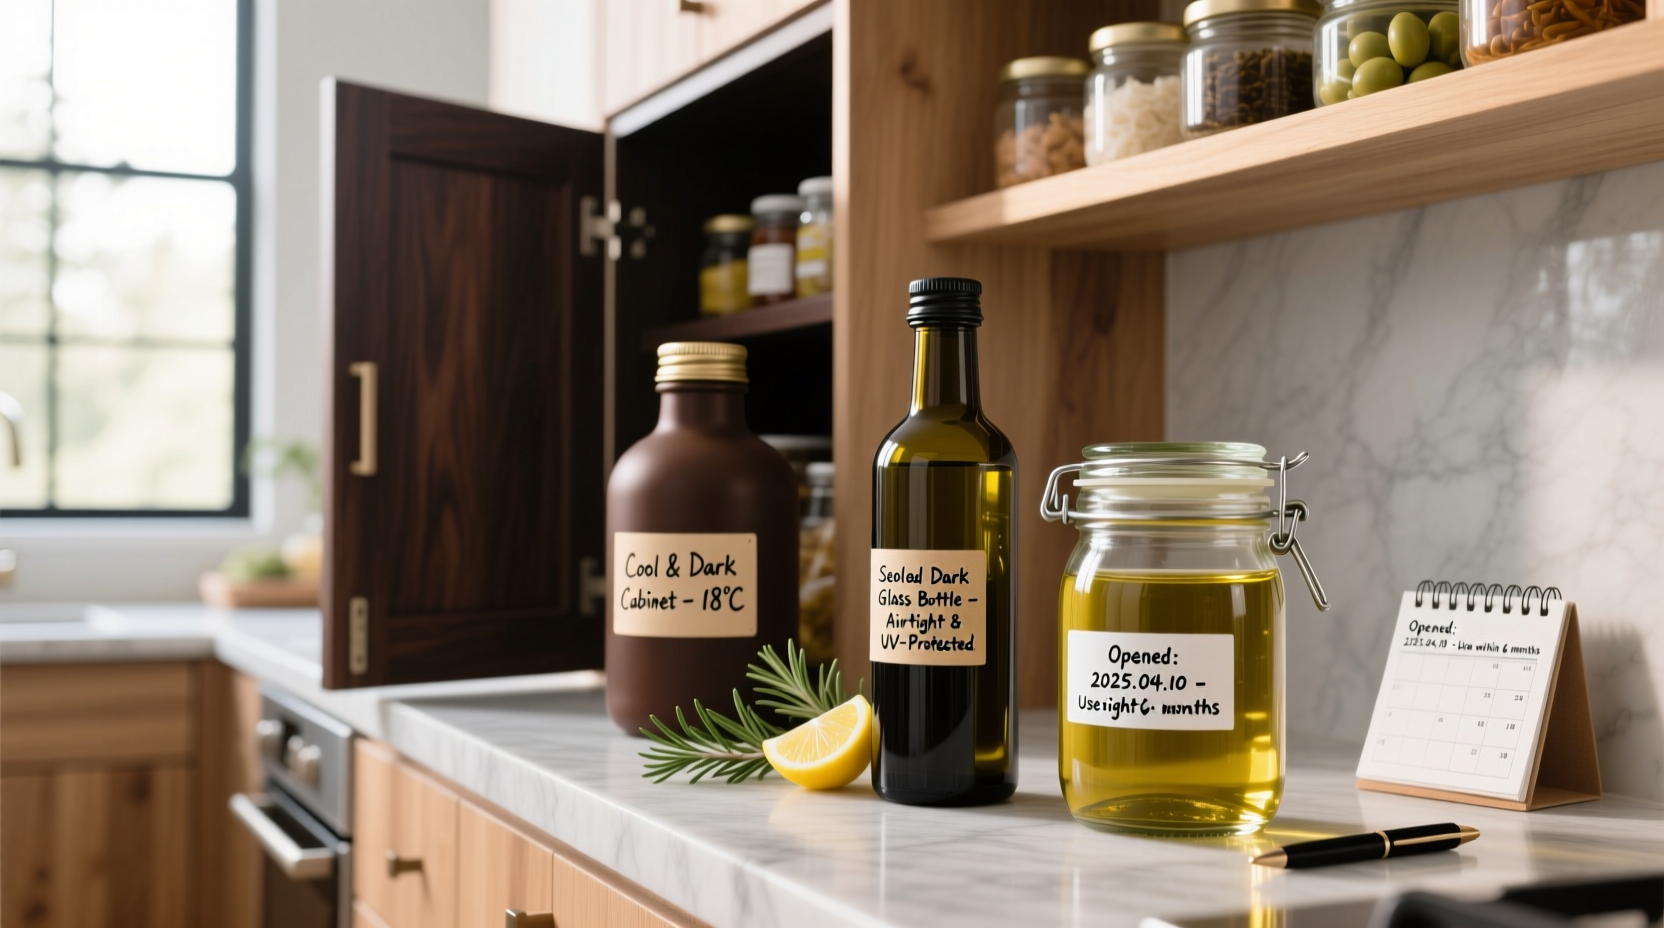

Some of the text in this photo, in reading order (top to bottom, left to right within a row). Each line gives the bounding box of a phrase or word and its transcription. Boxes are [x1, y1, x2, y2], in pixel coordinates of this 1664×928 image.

[625, 551, 737, 578] Cool & Dark
[931, 566, 970, 584] Dark
[621, 587, 677, 610] Cabinet
[878, 589, 912, 606] Glass
[918, 590, 962, 607] Bottle
[886, 612, 961, 634] Airtight &
[1409, 620, 1457, 635] Opened:
[1108, 644, 1178, 670] Opened:
[1090, 672, 1187, 692] 2025.04.10
